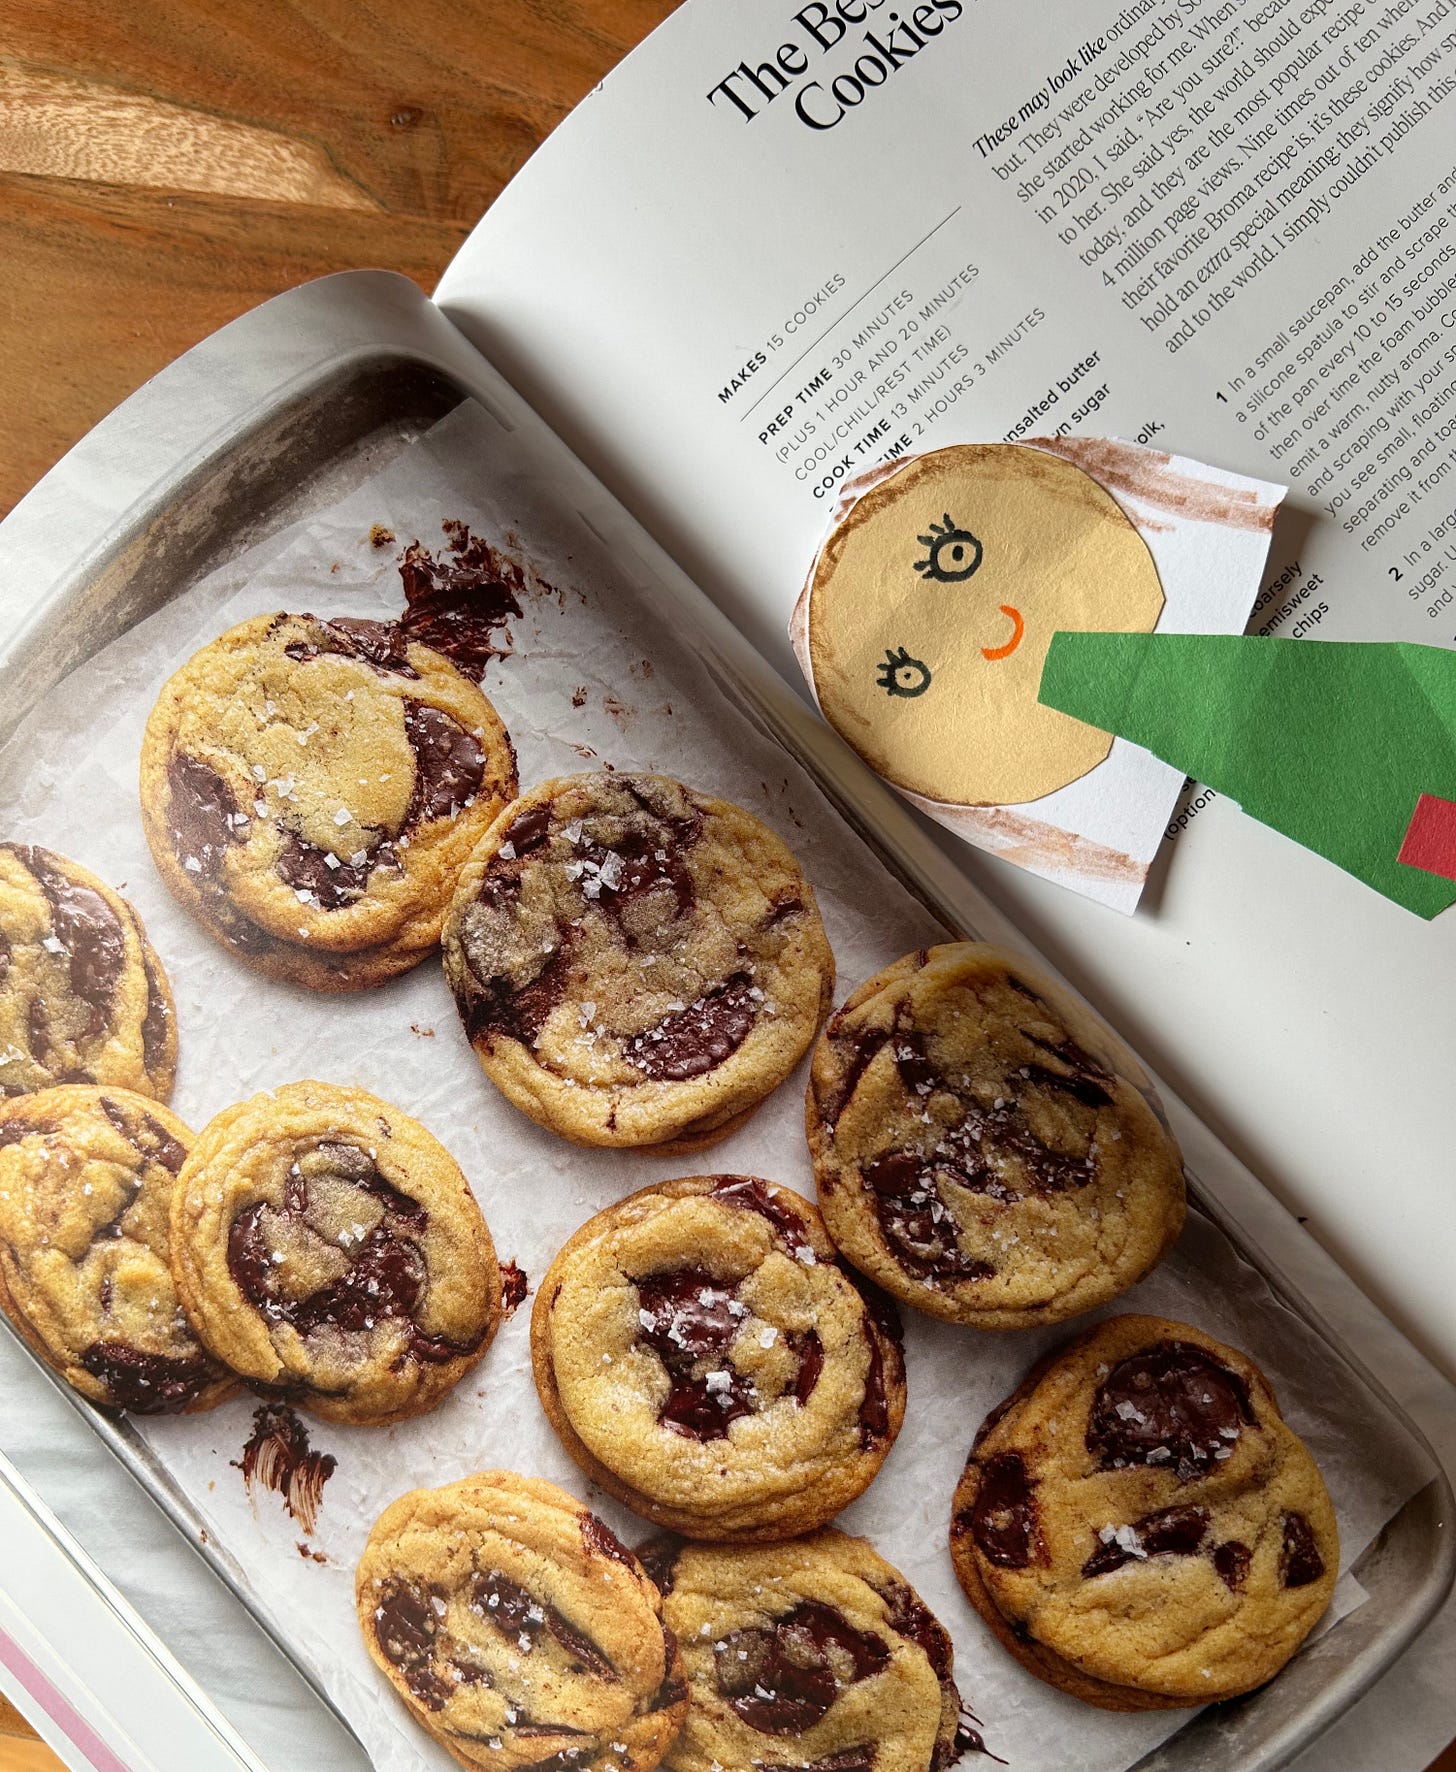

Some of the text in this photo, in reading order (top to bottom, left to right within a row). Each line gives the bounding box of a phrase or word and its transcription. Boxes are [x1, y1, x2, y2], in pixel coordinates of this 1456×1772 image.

[706, 42, 809, 124] The
[794, 0, 964, 131] Cookies
[972, 37, 1107, 158] These may look like
[992, 9, 1183, 180] but. They were developed by
[1017, 2, 1238, 203] she started working for me. When
[1035, 27, 1244, 224] in 2020, said, “Are you sure?!”
[1058, 19, 1302, 245] to her. She said yes, the world should
[1079, 3, 1365, 266] today, and they are the most popular recipe
[1114, 228, 1167, 277] million
[1164, 196, 1199, 234] page
[1197, 158, 1243, 196] views.
[1236, 124, 1277, 159] Nine
[1274, 88, 1316, 125] times
[1315, 65, 1341, 90] out
[1339, 45, 1357, 68] of
[1354, 29, 1381, 52] ten
[1122, 1, 1449, 309] their favorite Broma recipe it’s these cookies. And
[1140, 48, 1442, 332] hold an extra special meaning: they signify how
[1166, 76, 1455, 353] and to the world. simply couldn’t publish this
[718, 274, 845, 403] MAKES 15 COOKIES
[758, 290, 913, 445] PREP TIME 30 MINUTES
[776, 264, 979, 464] (PLUS 1 HOUR AND 20 MINUTES
[1056, 350, 1102, 394] butter
[1216, 192, 1437, 403] 1 In small saucepan, add the butter
[1246, 218, 1449, 413] silicone spatula to stir and scrape
[1254, 245, 1455, 440] of the pan every 10 to 15 seconds
[795, 325, 951, 480] COOL/CHILL/REST TIME)
[813, 345, 968, 498] COOK TIME 13 MINUTES
[878, 308, 1045, 462] IME 2 HOURS 3 MINUTES
[1071, 383, 1111, 424] sugar
[1269, 320, 1415, 459] then over time the foam
[1290, 332, 1443, 477] emit warm, nutty aroma.
[1308, 360, 1443, 496] and scraping with your
[1324, 427, 1416, 518] you see small,
[1343, 438, 1436, 533] separating and
[1361, 463, 1451, 552] remove it from
[1257, 573, 1324, 637] emisweet
[1292, 601, 1329, 639] chips
[1388, 551, 1421, 582] 2 In
[1409, 561, 1448, 600] sugar.
[1427, 589, 1453, 618] and
